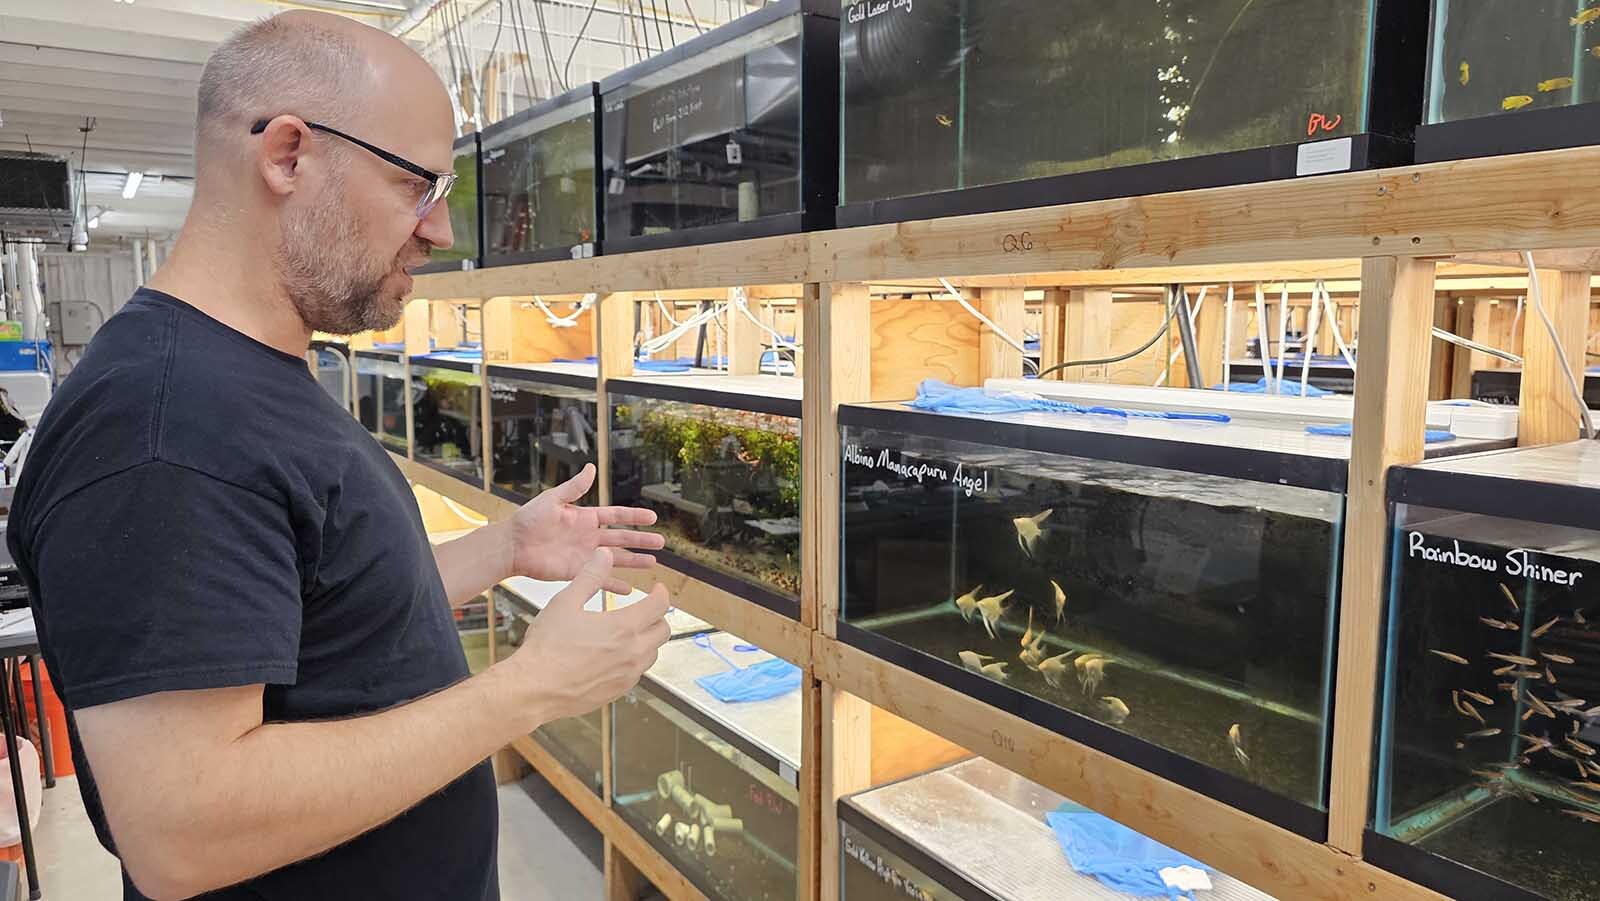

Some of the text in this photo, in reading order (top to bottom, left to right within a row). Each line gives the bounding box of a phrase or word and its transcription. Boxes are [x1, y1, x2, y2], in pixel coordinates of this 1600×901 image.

[848, 3, 865, 23] Gold
[867, 1, 890, 17] Laser
[1307, 112, 1341, 136] BW
[844, 444, 988, 497] Albino Manacapuru Angel
[1409, 531, 1583, 586] Rainbow Shiner
